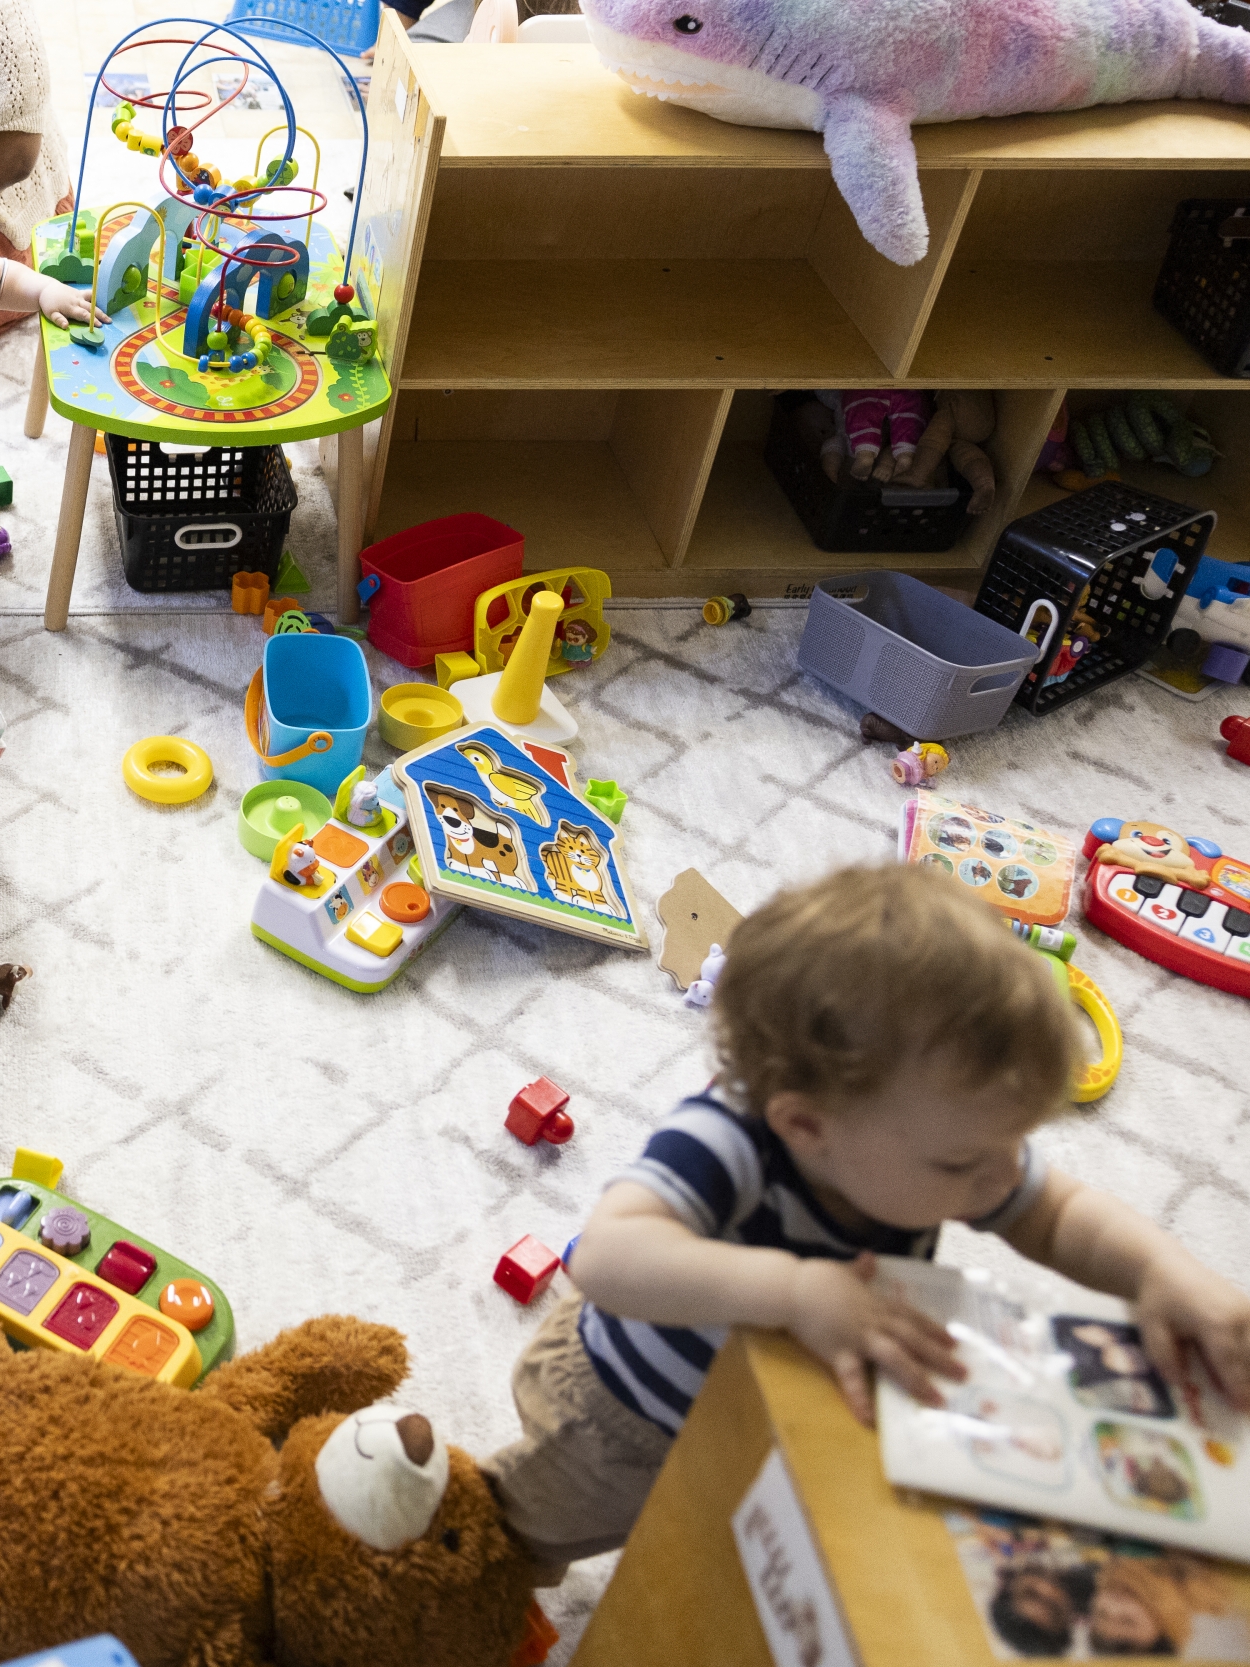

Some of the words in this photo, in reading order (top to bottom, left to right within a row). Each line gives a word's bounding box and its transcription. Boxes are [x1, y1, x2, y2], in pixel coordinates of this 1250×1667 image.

[786, 583, 810, 594] Early
[1123, 891, 1132, 899] 1
[1157, 909, 1170, 919] 2
[1200, 929, 1211, 939] 3
